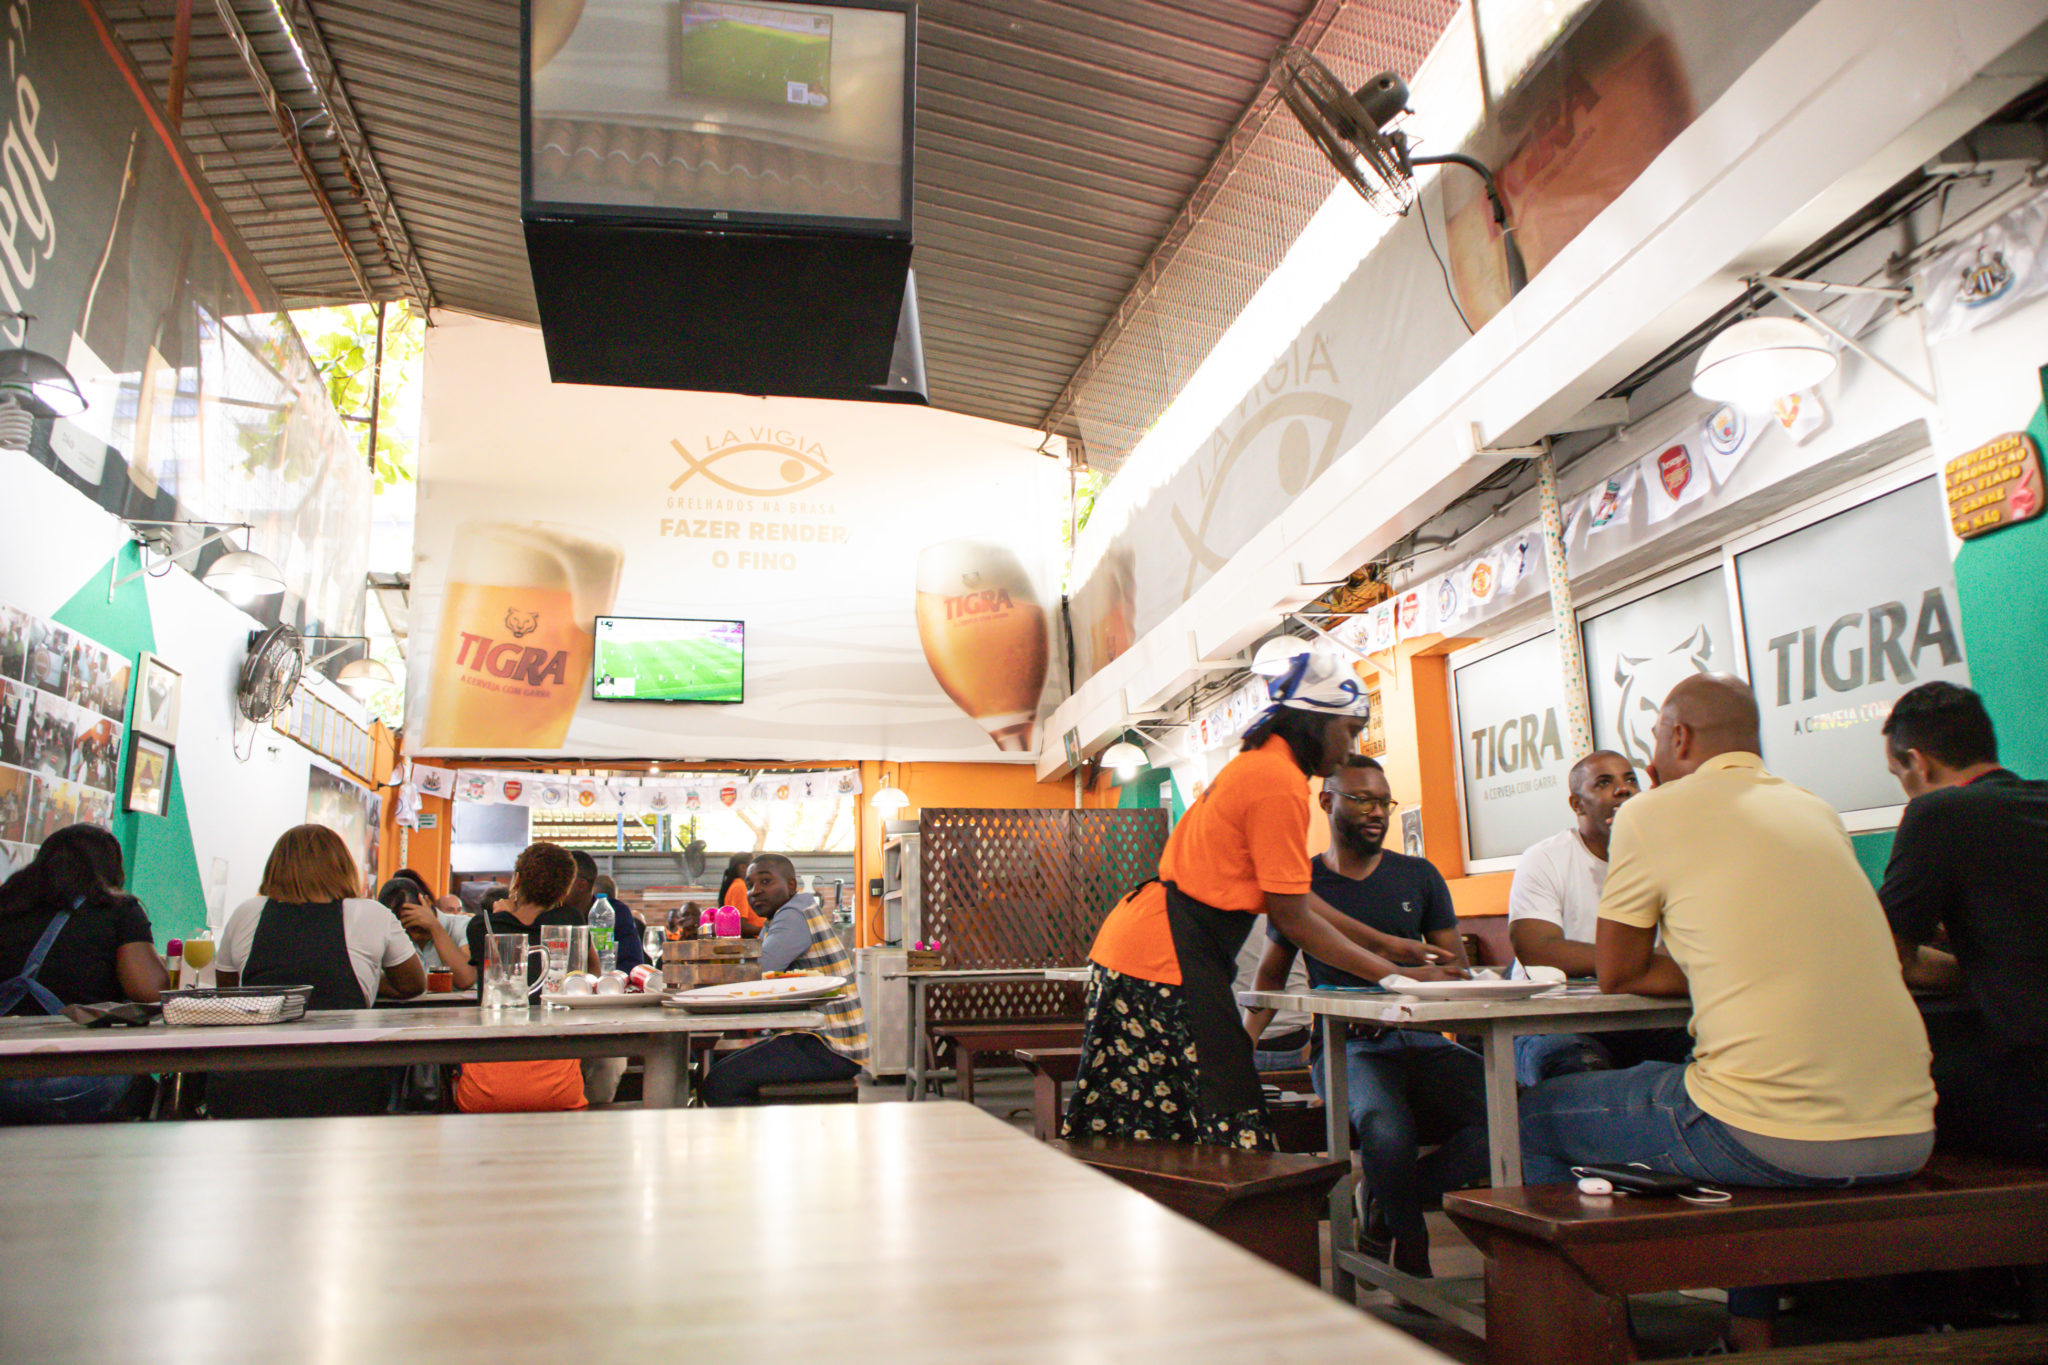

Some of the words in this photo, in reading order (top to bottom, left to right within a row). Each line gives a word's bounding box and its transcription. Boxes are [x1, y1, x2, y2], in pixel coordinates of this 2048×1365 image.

[705, 430, 741, 452] LA
[749, 426, 829, 464] VIGIA
[666, 496, 754, 513] GRELHADOS
[762, 499, 782, 514] NA
[789, 501, 837, 516] BRASA
[659, 517, 741, 540] FAZER
[711, 549, 729, 569] O
[738, 551, 797, 571] FINO
[944, 588, 1015, 620] TIGRA
[456, 631, 569, 687] TIGRA
[1768, 586, 1963, 707] TIGRA
[1471, 707, 1564, 781] TIGRA
[1794, 720, 1803, 736] A
